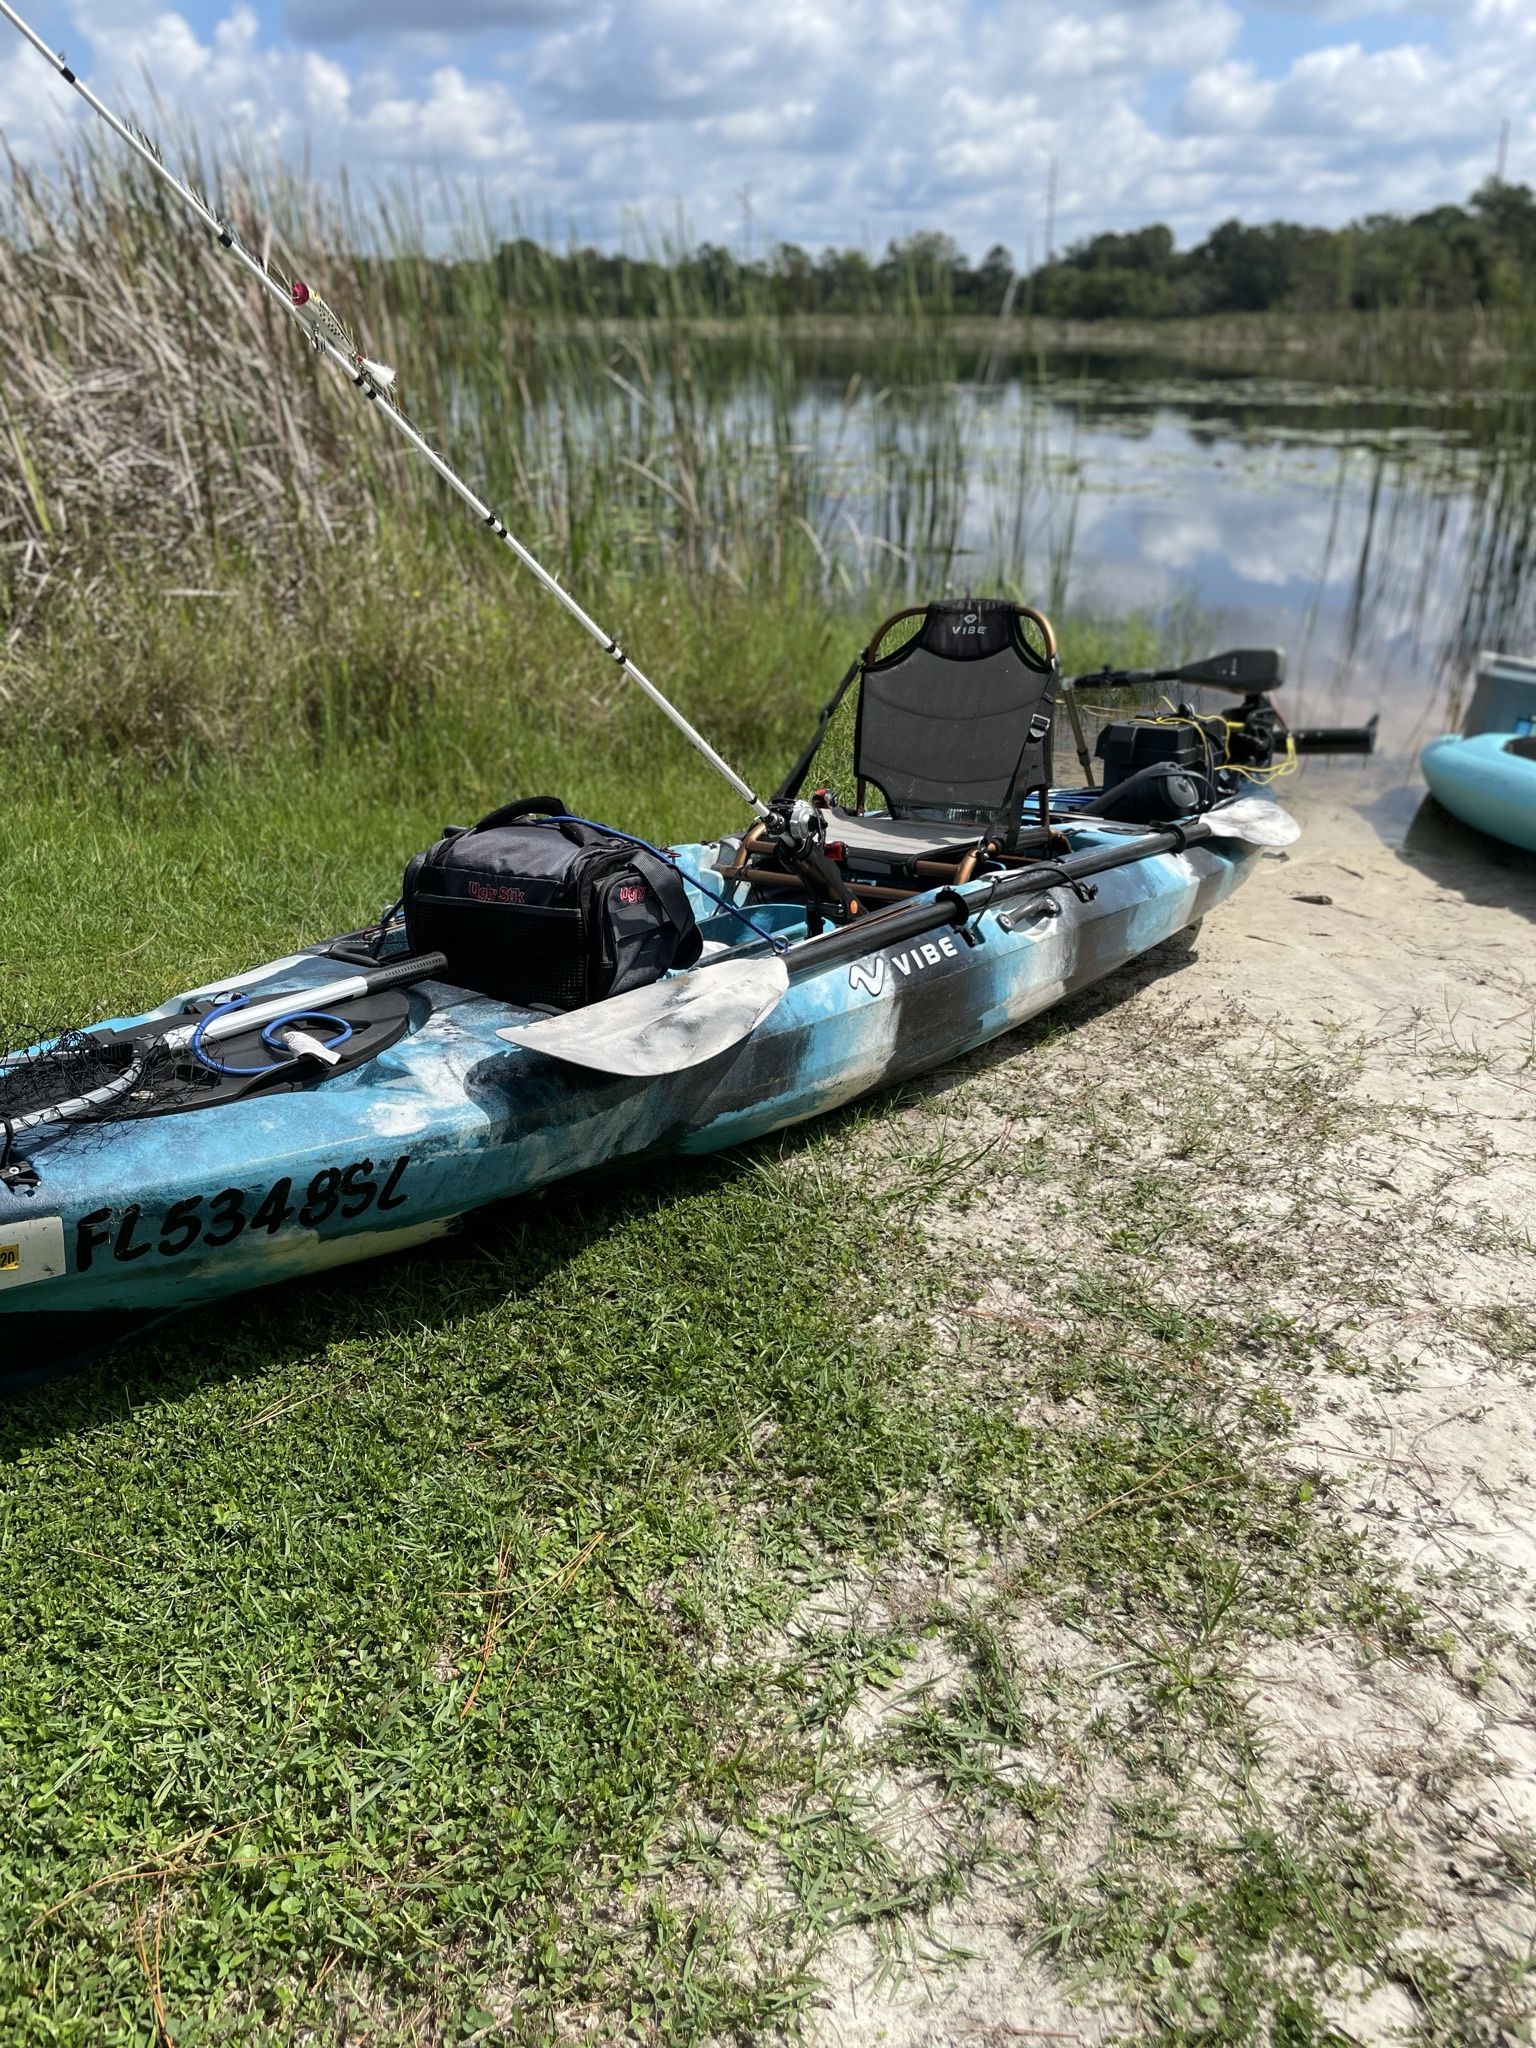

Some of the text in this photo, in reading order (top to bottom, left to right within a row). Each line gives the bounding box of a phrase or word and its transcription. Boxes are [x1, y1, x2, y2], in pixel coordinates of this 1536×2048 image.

[952, 626, 987, 635] VIBE
[468, 880, 525, 904] Ugly Stik
[891, 936, 959, 977] VIBE
[0, 1250, 16, 1269] 20
